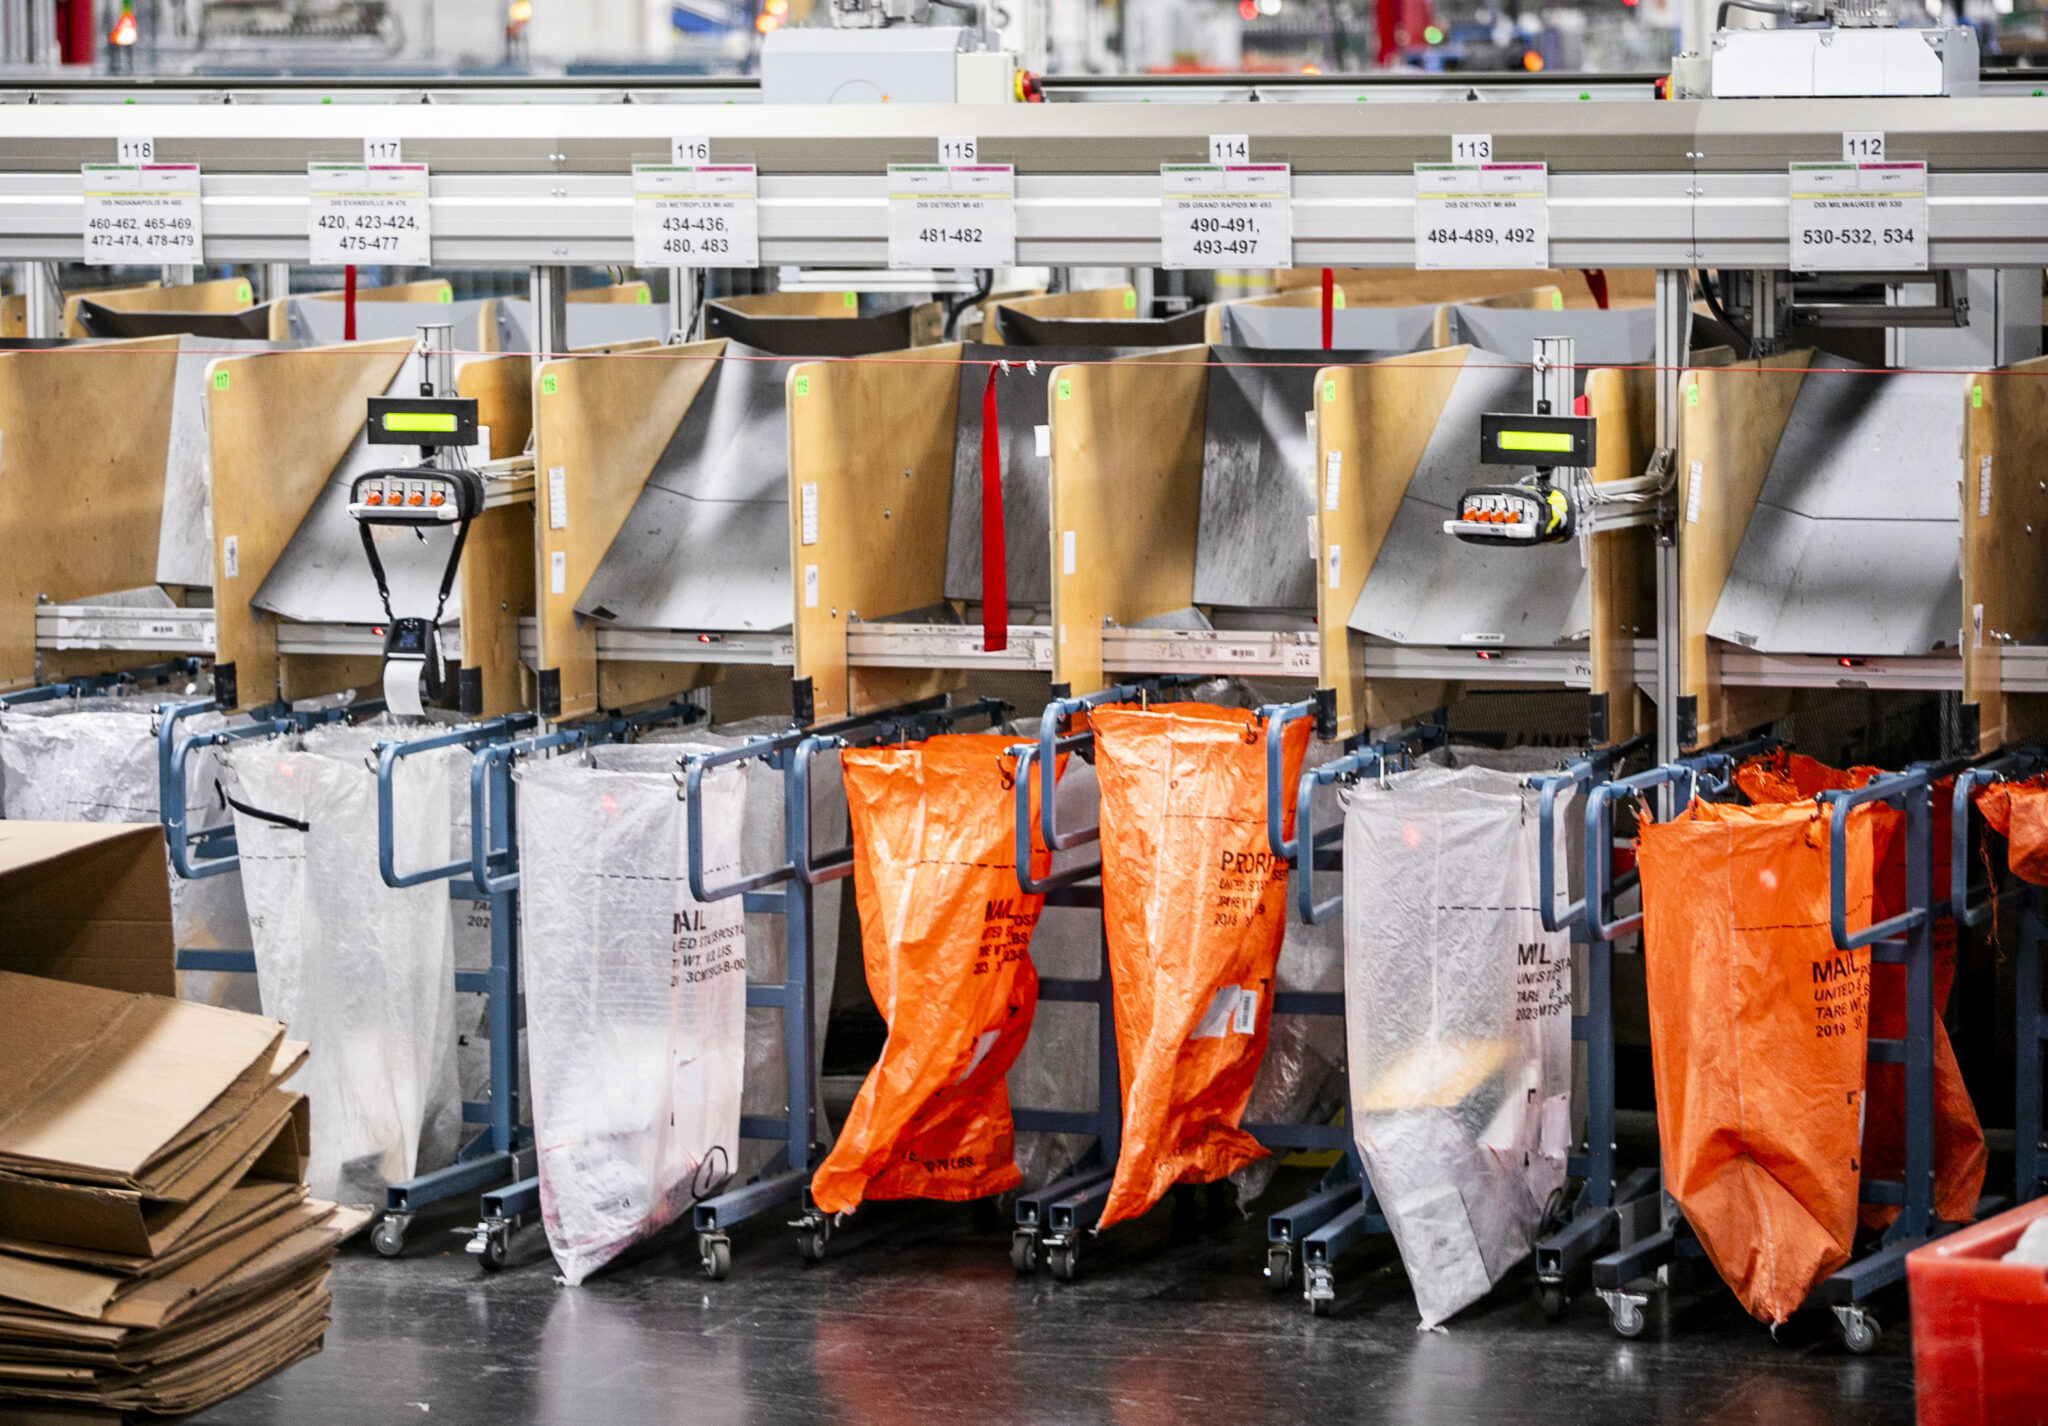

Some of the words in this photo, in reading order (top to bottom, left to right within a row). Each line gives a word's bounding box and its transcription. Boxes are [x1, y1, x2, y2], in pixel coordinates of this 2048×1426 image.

[123, 143, 151, 158] 118
[369, 143, 397, 158] 117
[677, 144, 706, 159] 116
[944, 143, 974, 158] 115
[1215, 142, 1246, 157] 114
[1457, 141, 1489, 157] 113
[1848, 138, 1881, 155] 112
[318, 215, 350, 230] 420,
[355, 215, 420, 230] 423-424,
[662, 217, 728, 232] 434-436,
[1190, 218, 1260, 234] 490-491,
[146, 235, 194, 246] 478-479
[920, 228, 983, 242] 481-482
[1428, 228, 1499, 244] 484-489,
[1504, 228, 1535, 243] 492
[1803, 229, 1877, 245] 530-532,
[1883, 228, 1914, 243] 534
[339, 236, 399, 250] 475-477
[663, 238, 695, 253] 480,
[701, 238, 729, 253] 483
[1193, 240, 1258, 254] 493-497
[472, 900, 491, 911] TA
[468, 915, 491, 928] 202
[1812, 951, 1860, 983] MAIL
[1814, 981, 1856, 1001] UNITED
[1816, 1002, 1847, 1019] TARE
[1816, 1022, 1846, 1037] 2019
